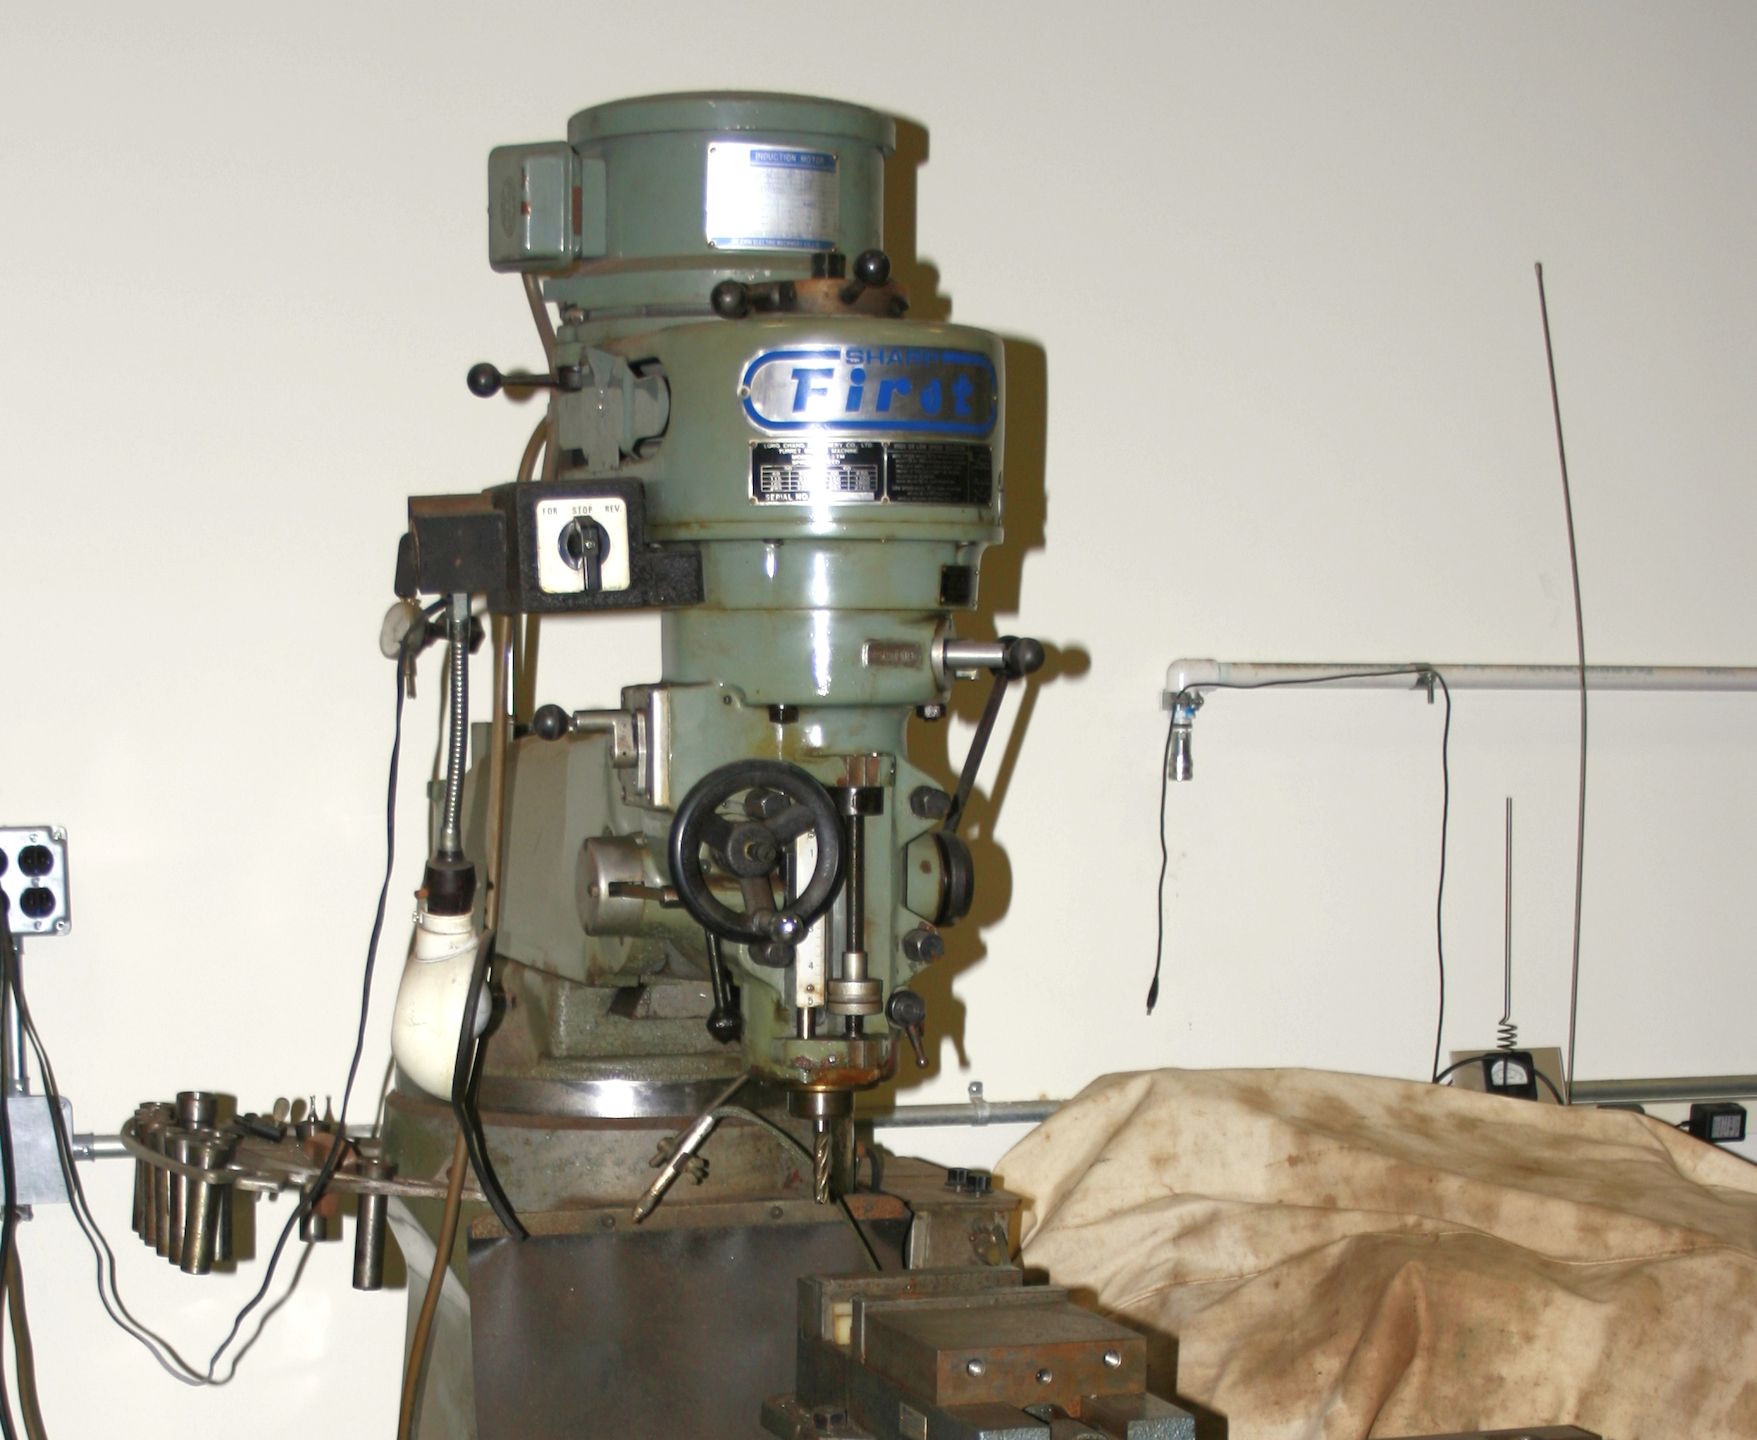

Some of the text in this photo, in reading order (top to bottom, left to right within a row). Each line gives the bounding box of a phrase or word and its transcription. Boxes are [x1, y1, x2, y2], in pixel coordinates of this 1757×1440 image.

[765, 493, 793, 502] SERIAL
[542, 507, 558, 516] FOR
[572, 505, 593, 515] STOP
